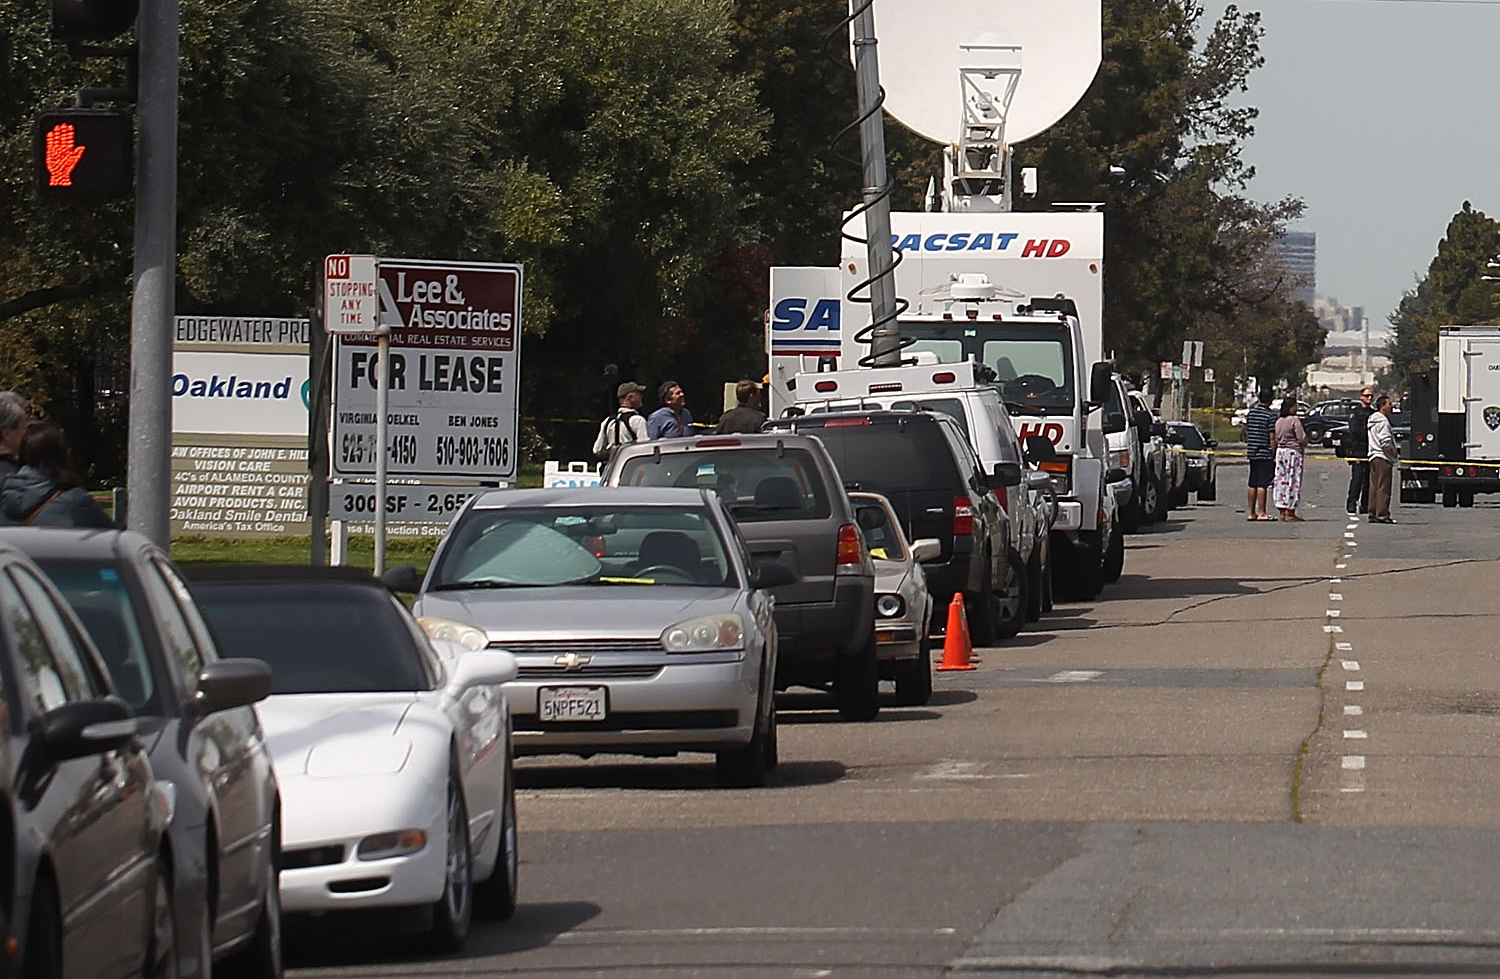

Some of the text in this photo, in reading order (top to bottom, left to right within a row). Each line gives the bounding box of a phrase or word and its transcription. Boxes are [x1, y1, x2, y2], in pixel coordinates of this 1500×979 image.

[1021, 239, 1071, 258] HD
[329, 259, 346, 277] NO
[330, 283, 373, 297] STOPPING
[397, 272, 465, 305] Lee &
[341, 300, 362, 311] ANY
[341, 313, 362, 324] TIME
[408, 304, 512, 332] Associates
[772, 298, 840, 331] SA
[177, 319, 272, 343] EDGEWATER
[344, 333, 511, 347] COMMEIAL REAL ESTATE SERVICES
[351, 351, 503, 394] FOR LEASE
[172, 374, 292, 399] Oakland
[340, 412, 420, 426] VIRGINIA OELKEL
[448, 415, 498, 428] BEN JONES
[1019, 423, 1064, 449] HD
[171, 447, 188, 458] AW
[190, 447, 231, 458] OFFICES
[233, 448, 247, 459] OF
[247, 448, 275, 460] JOHN
[277, 449, 287, 460] E.
[342, 433, 417, 464] 925-7-4150
[437, 436, 509, 467] 510-903-7606
[195, 460, 272, 471] VISION CARE
[174, 472, 309, 484] 4C's of ALAMEDA COUNTY
[176, 484, 303, 497] AIRPORT RENT A CAR
[173, 496, 305, 510] AVON PRODUCTS, INC.
[344, 494, 376, 512] 300
[386, 496, 407, 513] SF
[427, 494, 474, 515] 2,65
[170, 508, 308, 522] Oakland Smile Dental
[183, 521, 285, 532] America's Tax Office
[365, 525, 418, 535] Inuction
[544, 700, 601, 716] 5NPF521
